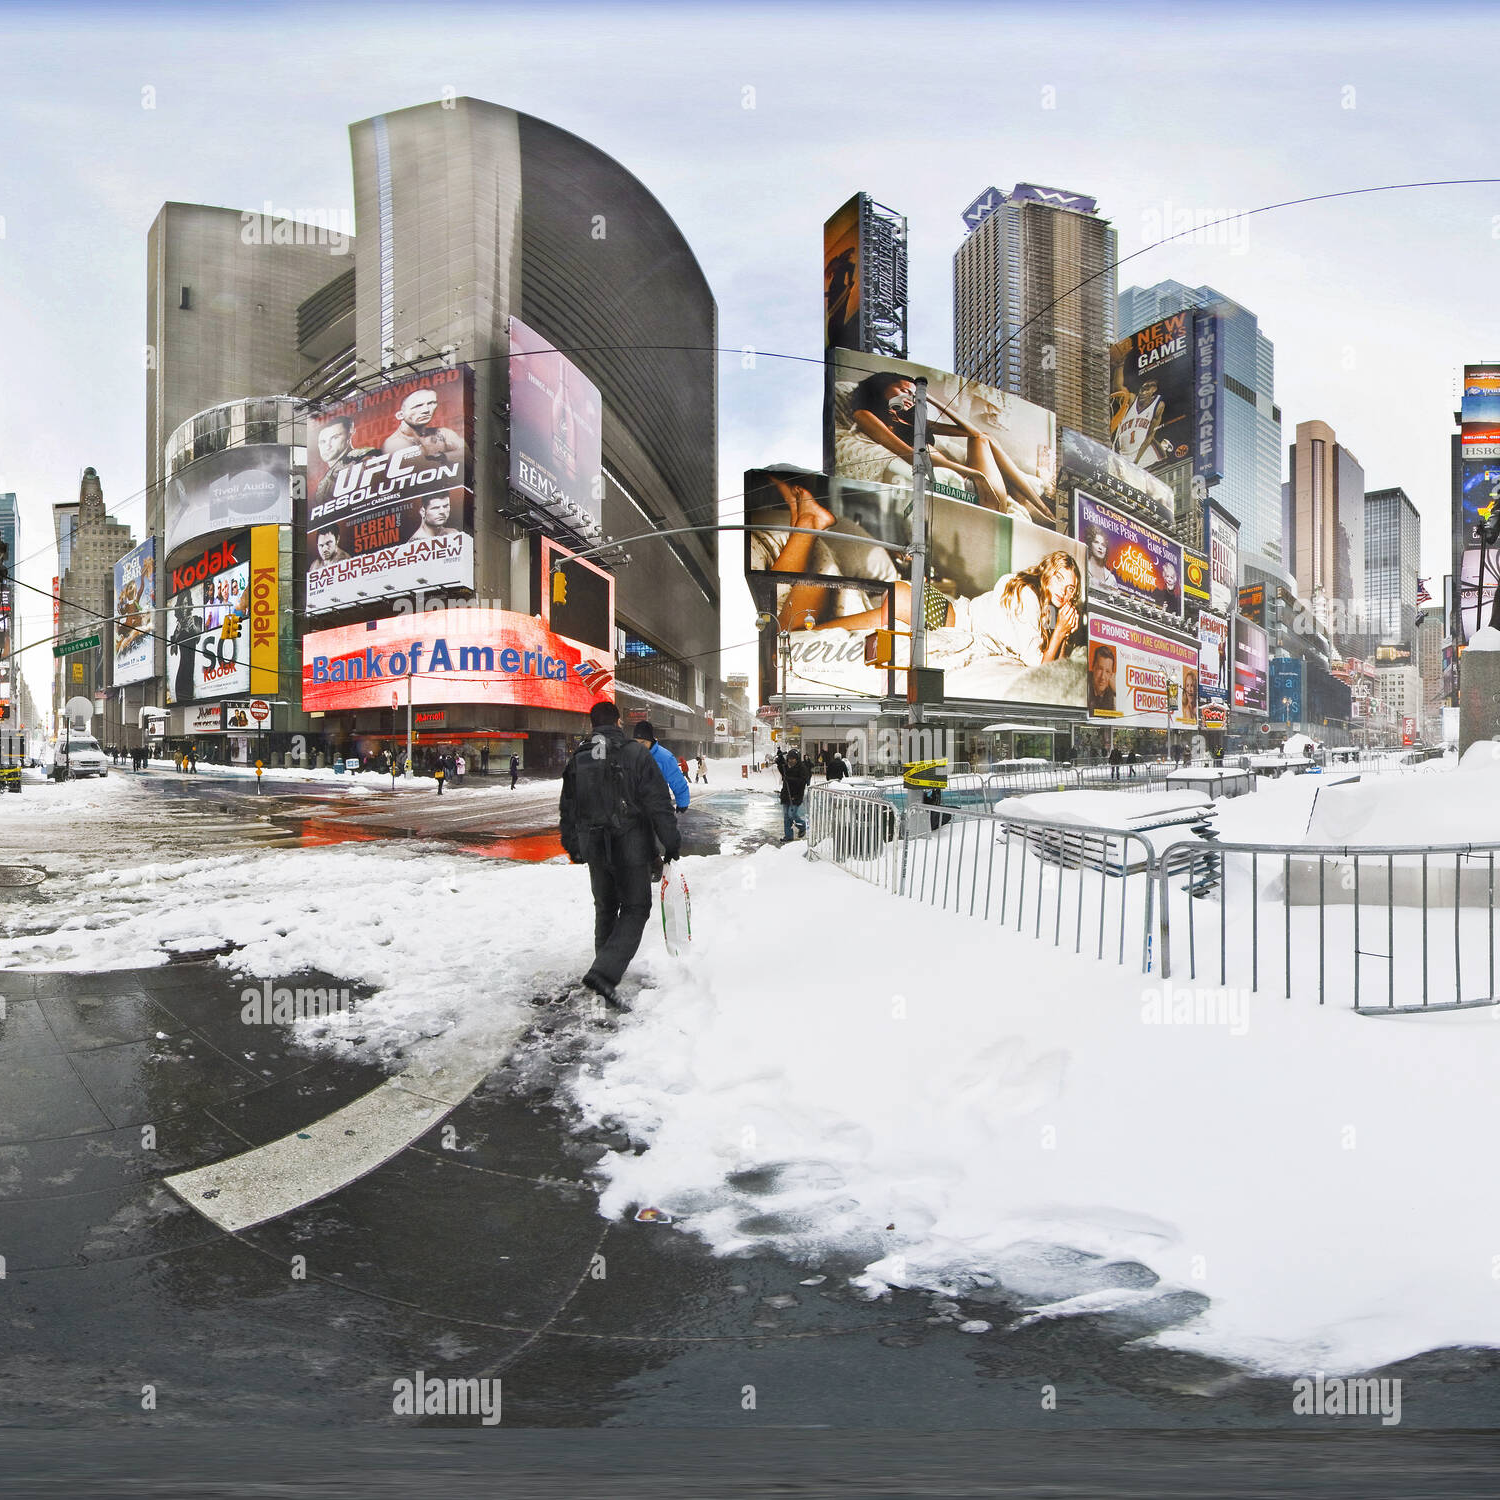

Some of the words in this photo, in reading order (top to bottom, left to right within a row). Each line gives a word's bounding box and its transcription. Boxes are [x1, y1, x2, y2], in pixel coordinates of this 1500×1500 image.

[879, 256, 893, 312] AMERICAN
[1137, 312, 1186, 347] NEW
[1138, 326, 1187, 355] YORK'S
[1196, 316, 1215, 367] TIMES
[1137, 335, 1187, 369] GAME
[364, 368, 460, 409] MAYNARD
[1119, 418, 1133, 434] NEW
[1134, 417, 1150, 429] YORK
[1197, 372, 1216, 456] SQUARE
[1129, 430, 1136, 444] 1
[1465, 447, 1500, 455] HSBC
[333, 444, 422, 498] UFC
[519, 460, 557, 496] RÉMY
[213, 485, 239, 497] Tivoli
[243, 482, 275, 491] Audio
[310, 463, 459, 521] RESOLUTION
[935, 484, 976, 502] BROADWAY
[1096, 472, 1158, 512] TEMPEST
[346, 509, 390, 527] MIDDLEWEIGHT
[391, 502, 414, 515] BATTLE
[354, 514, 396, 539] LEBEN
[1083, 506, 1120, 535] BERNADETTE
[1120, 524, 1139, 543] PETERS
[1096, 504, 1128, 526] CLOSES
[1129, 521, 1161, 544] JANUARY
[354, 527, 400, 553] STANN
[1147, 540, 1163, 558] ELAINE
[1163, 547, 1178, 565] STRITCH
[1212, 539, 1230, 568] BILLY
[122, 555, 140, 575] YOGI
[122, 566, 142, 586] BEAR
[172, 540, 238, 594] Kodak
[309, 547, 400, 582] SATURDAY
[309, 577, 334, 591] LIVE
[338, 571, 357, 582] ON
[361, 546, 462, 578] PAY-PER-VIEW
[1187, 563, 1203, 587] Q
[253, 567, 276, 648] Kodak
[1101, 624, 1131, 640] PROMISE
[1130, 632, 1141, 644] YOU
[1143, 635, 1153, 648] ARE
[1153, 639, 1171, 653] GOING
[1170, 645, 1176, 654] TO
[1176, 647, 1187, 659] LOVE
[1200, 616, 1228, 638] HEIGHTS
[59, 639, 93, 654] Broadway
[202, 635, 236, 671] SO
[313, 648, 384, 684] Bank
[389, 641, 422, 674] of
[428, 638, 568, 682] America
[203, 661, 237, 683] Kodak
[415, 711, 445, 723] Marriott
